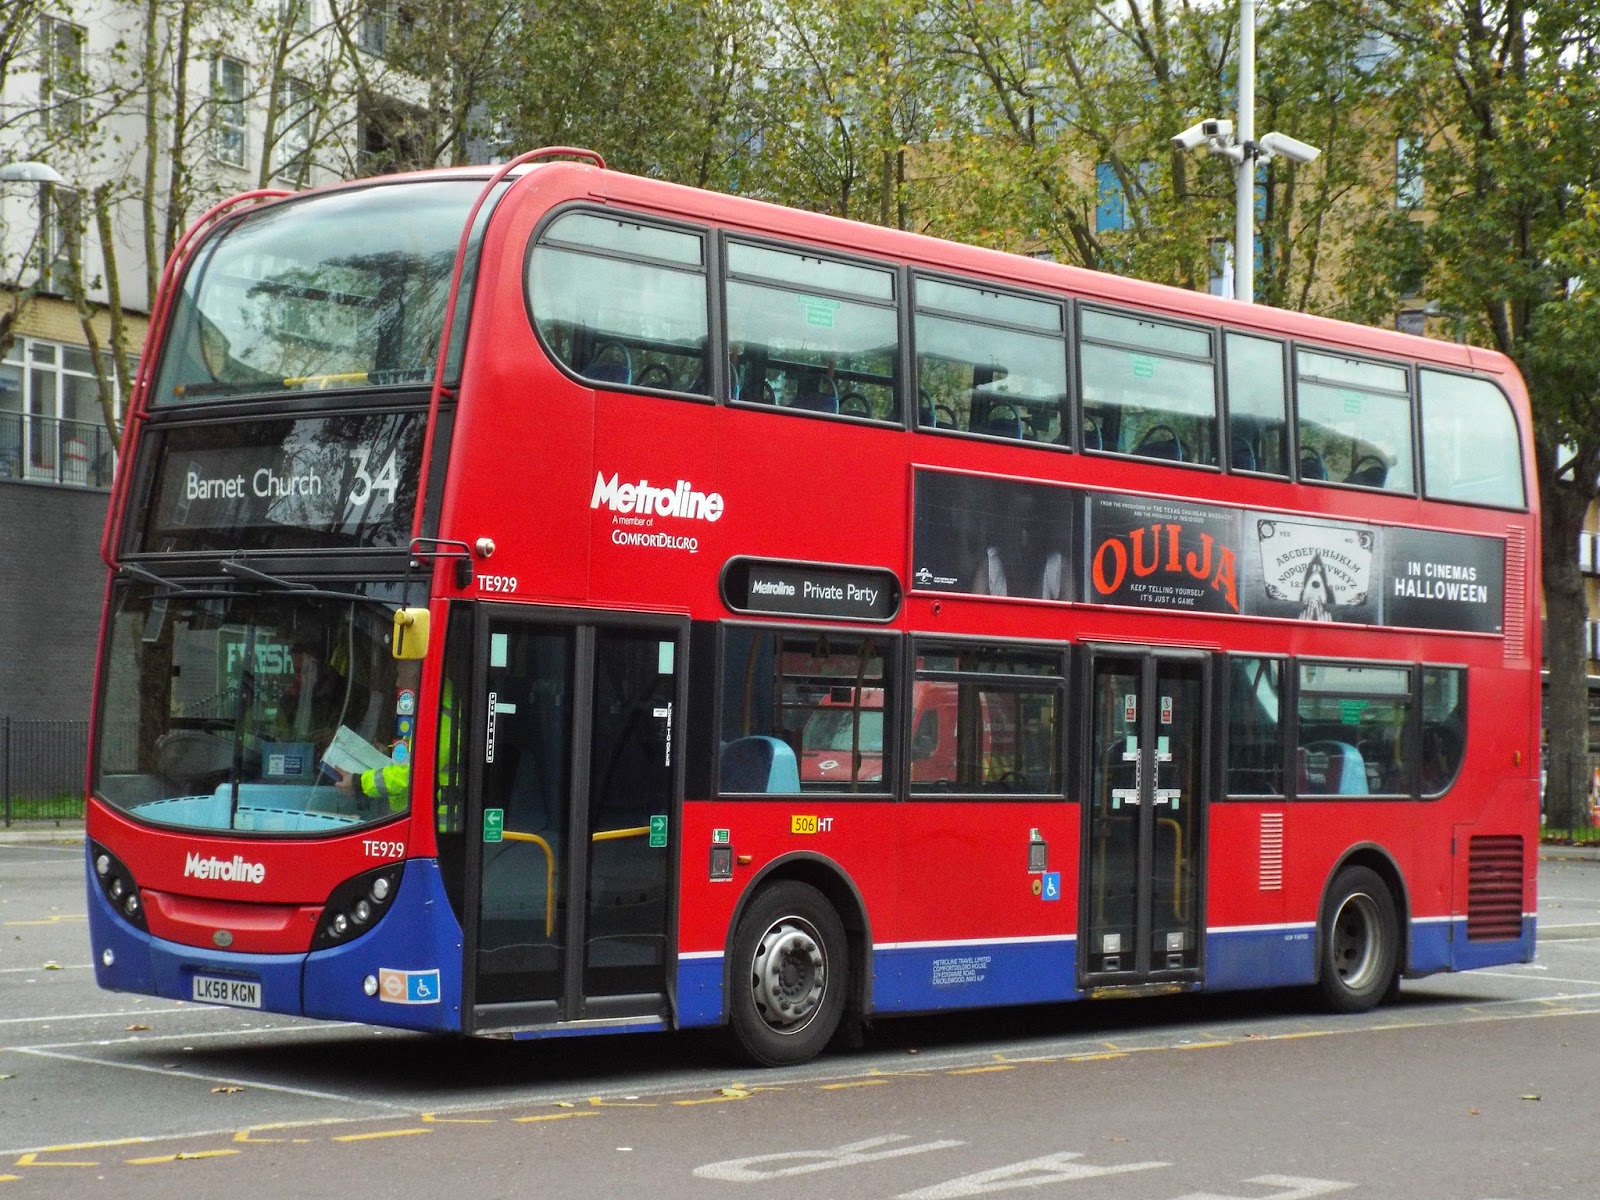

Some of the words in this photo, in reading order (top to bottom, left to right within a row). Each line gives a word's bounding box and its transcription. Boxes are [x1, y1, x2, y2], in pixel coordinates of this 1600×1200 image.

[186, 472, 245, 500] Barnet
[252, 467, 322, 498] Church
[349, 447, 398, 505] 34
[590, 470, 724, 522] Metroline
[1153, 505, 1163, 513] THE
[1164, 506, 1180, 514] TEXAS
[619, 518, 645, 526] member
[646, 518, 653, 526] of
[1092, 523, 1240, 612] OUIJA
[1408, 561, 1420, 576] IN
[1425, 562, 1477, 581] CINEMAS
[477, 574, 518, 593] TE929
[752, 580, 795, 596] Metroline
[803, 581, 843, 600] Private
[847, 584, 878, 606] Party
[1130, 583, 1146, 592] KEEP
[1148, 585, 1174, 594] TELLING
[1175, 587, 1205, 597] YOURSELF
[1394, 578, 1488, 603] HALLOWEEN
[1140, 594, 1153, 602] IT'S
[1154, 595, 1170, 604] JUST
[1178, 597, 1194, 606] GAME
[795, 817, 815, 832] 506
[817, 817, 833, 832] HT
[362, 840, 404, 858] TE929
[184, 852, 265, 884] Metroline
[196, 978, 229, 1000] LK58
[231, 982, 255, 1003] KGN
